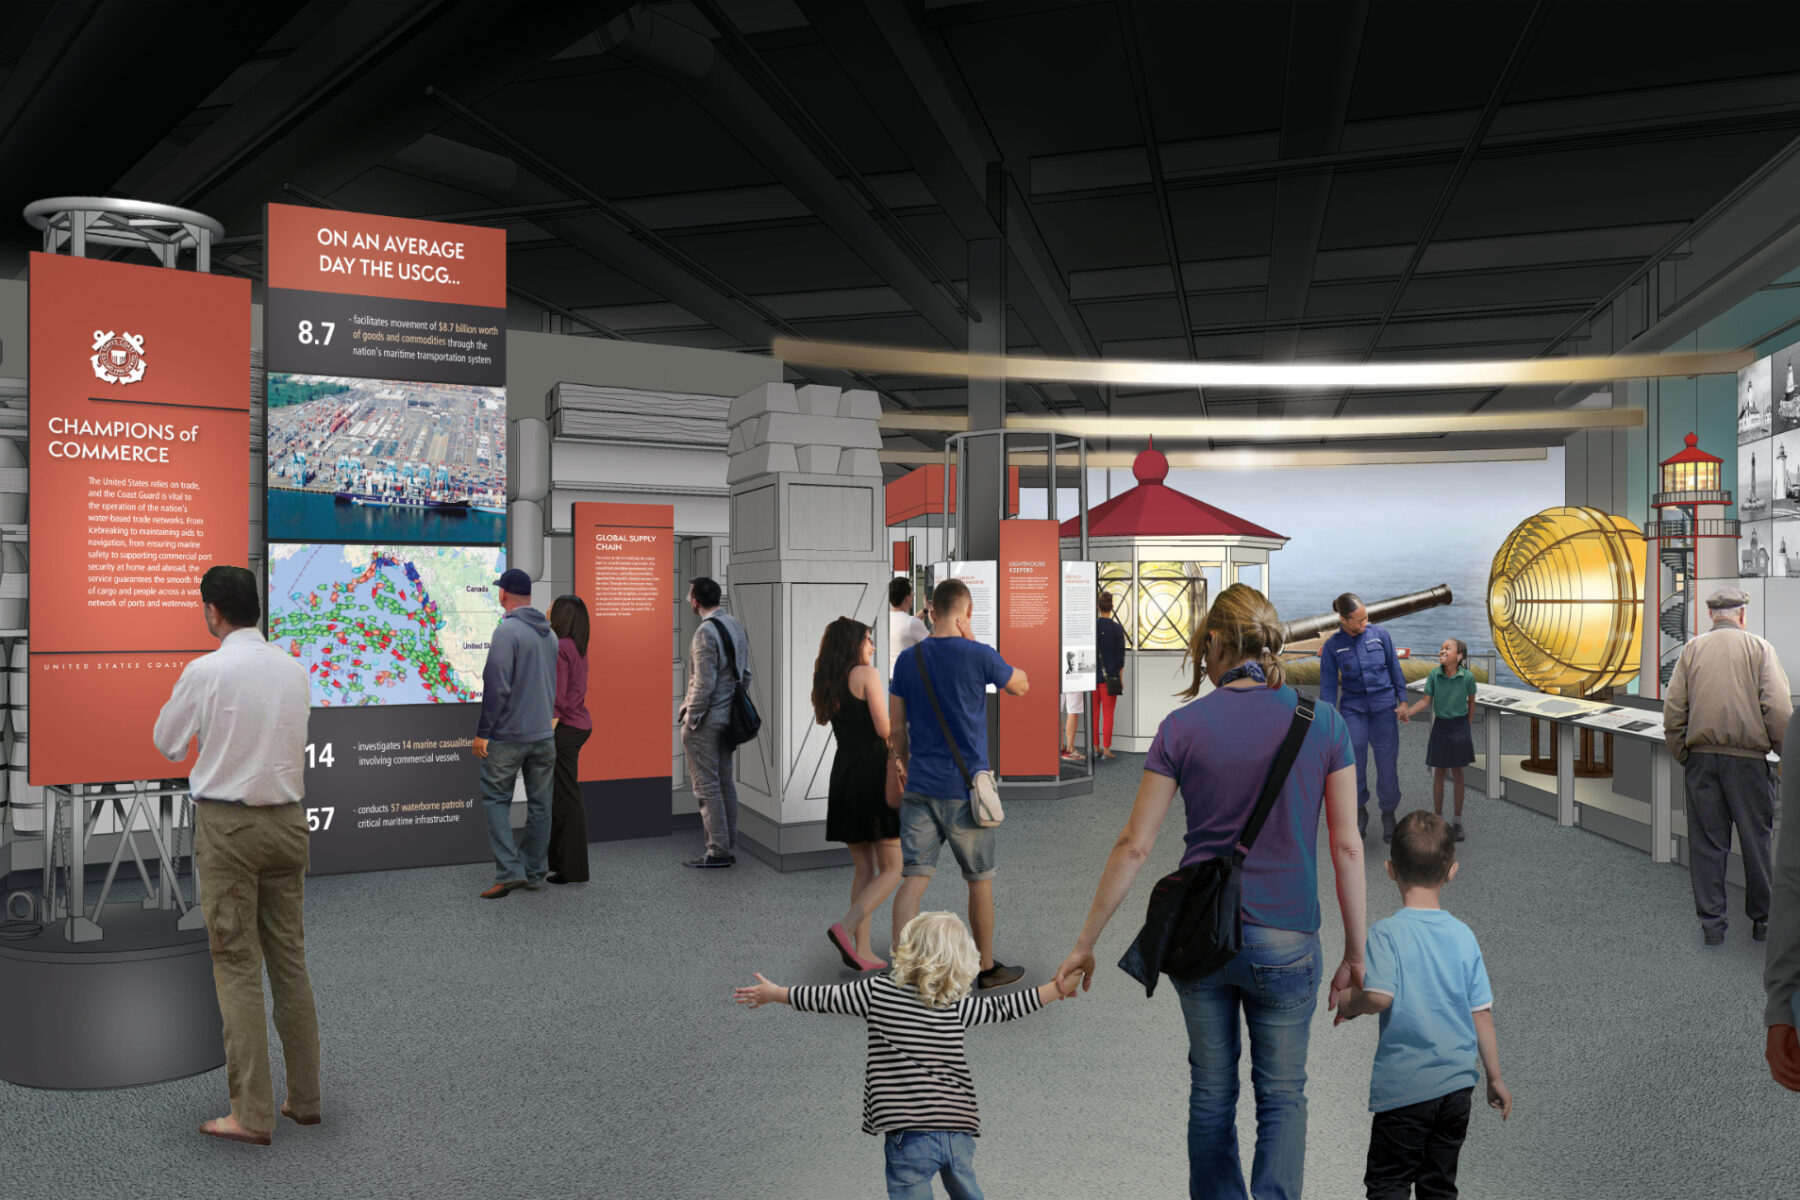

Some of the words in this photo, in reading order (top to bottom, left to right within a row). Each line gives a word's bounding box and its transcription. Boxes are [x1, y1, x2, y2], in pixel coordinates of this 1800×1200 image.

[318, 228, 348, 247] ON
[352, 232, 379, 250] AN
[384, 236, 464, 259] AVERAGE
[319, 255, 355, 274] DAY
[359, 259, 394, 278] THE
[398, 263, 460, 285] USCG...
[353, 315, 388, 327] facilitates
[390, 320, 427, 330] movement
[430, 321, 437, 331] of
[439, 322, 454, 332] $8.7
[455, 323, 477, 334] billion
[478, 325, 498, 335] worth
[298, 320, 335, 345] 8.7
[353, 329, 361, 339] of
[362, 330, 385, 342] goods
[386, 332, 400, 341] and
[401, 334, 446, 345] commodities
[447, 338, 475, 351] through
[476, 340, 487, 350] the
[353, 346, 382, 356] nation's
[383, 348, 415, 359] maritime
[417, 351, 466, 362] transportation
[468, 355, 491, 365] system
[48, 417, 175, 441] CHAMPIONS
[179, 425, 199, 442] of
[49, 441, 169, 463] COMMERCE
[88, 476, 101, 485] The
[103, 477, 126, 486] United
[128, 478, 149, 487] States
[150, 480, 168, 488] relies
[180, 481, 200, 490] trade,
[88, 489, 101, 497] and
[104, 489, 115, 498] the
[117, 490, 137, 499] Coast
[138, 491, 159, 499] Guard
[161, 492, 167, 500] is
[169, 492, 182, 500] vital
[184, 493, 192, 501] to
[88, 501, 100, 510] the
[102, 502, 136, 512] operation
[138, 503, 146, 511] of
[88, 515, 131, 523] water-based
[133, 515, 150, 523] trade
[186, 517, 203, 525] From
[88, 526, 128, 536] icebreaking
[130, 527, 137, 535] to
[139, 528, 179, 538] maintaining
[181, 528, 194, 536] aids
[196, 529, 204, 537] to
[129, 539, 145, 547] from
[147, 540, 176, 549] ensuring
[178, 540, 200, 548] marine
[88, 550, 110, 559] safety
[120, 552, 157, 561] supporting
[159, 552, 196, 560] commercial
[198, 553, 212, 561] port
[88, 563, 114, 572] security
[126, 563, 145, 571] home
[147, 563, 160, 572] and
[188, 564, 199, 572] the
[88, 575, 112, 583] service
[114, 576, 152, 584] guarantees
[154, 575, 164, 583] the
[167, 576, 191, 584] smooth
[88, 586, 96, 595] of
[97, 588, 116, 596] cargo
[119, 587, 131, 595] and
[134, 587, 156, 596] people
[88, 599, 116, 607] network
[118, 599, 126, 607] of
[128, 599, 145, 608] ports
[147, 599, 160, 607] and
[357, 741, 400, 752] investigates
[402, 740, 411, 749] 14
[413, 739, 437, 749] marine
[305, 743, 335, 768] 14
[359, 756, 391, 766] involving
[393, 753, 433, 765] commercial
[435, 752, 459, 762] vessels
[357, 804, 389, 814] conducts
[391, 803, 399, 812] 57
[401, 801, 440, 811] waterborne
[442, 800, 464, 811] patrols
[466, 799, 473, 808] of
[306, 807, 335, 831] 57
[358, 818, 381, 828] critical
[383, 816, 413, 826] maritime
[415, 814, 459, 824] infrastructure
